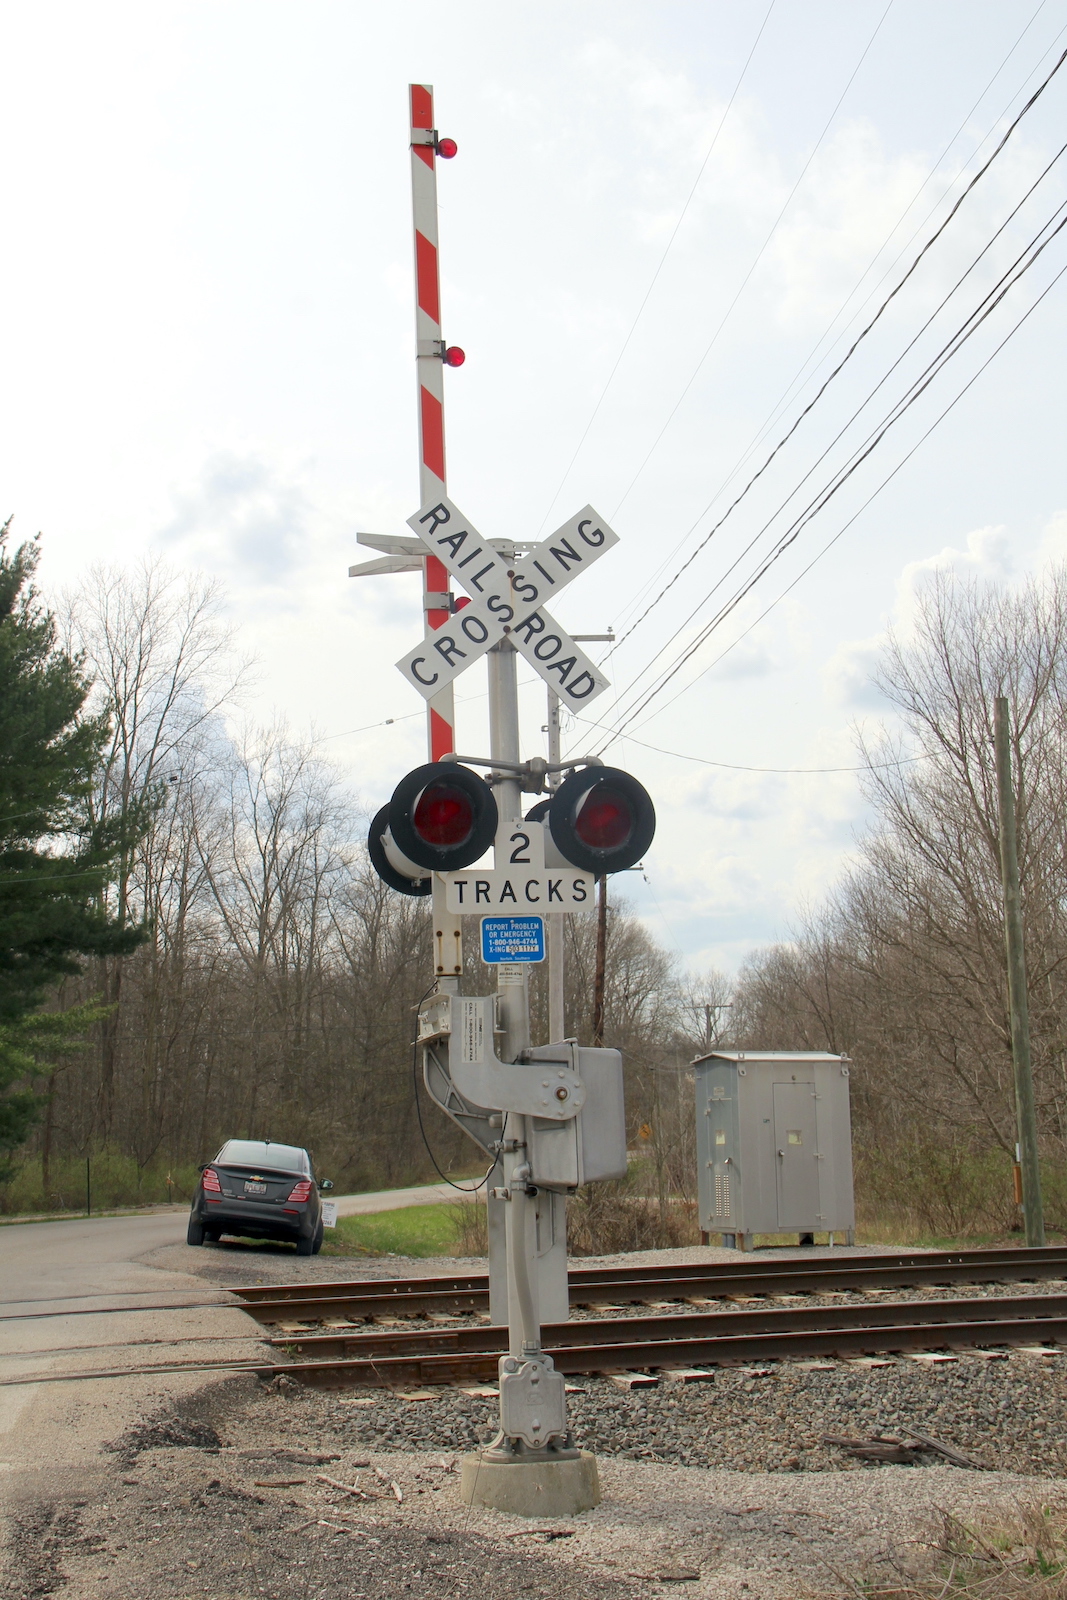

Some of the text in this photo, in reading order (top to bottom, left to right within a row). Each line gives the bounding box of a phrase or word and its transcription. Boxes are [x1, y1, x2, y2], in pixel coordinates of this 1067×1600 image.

[410, 519, 606, 686] CROSSING
[419, 502, 596, 700] RAIL ROAD
[509, 832, 531, 864] 2
[453, 878, 587, 904] TRACKS
[485, 922, 539, 931] REPORT PROBLEM
[500, 930, 536, 938] EMERGENCY
[488, 938, 538, 946] 1-800-946-4744
[489, 945, 506, 953] X-ING
